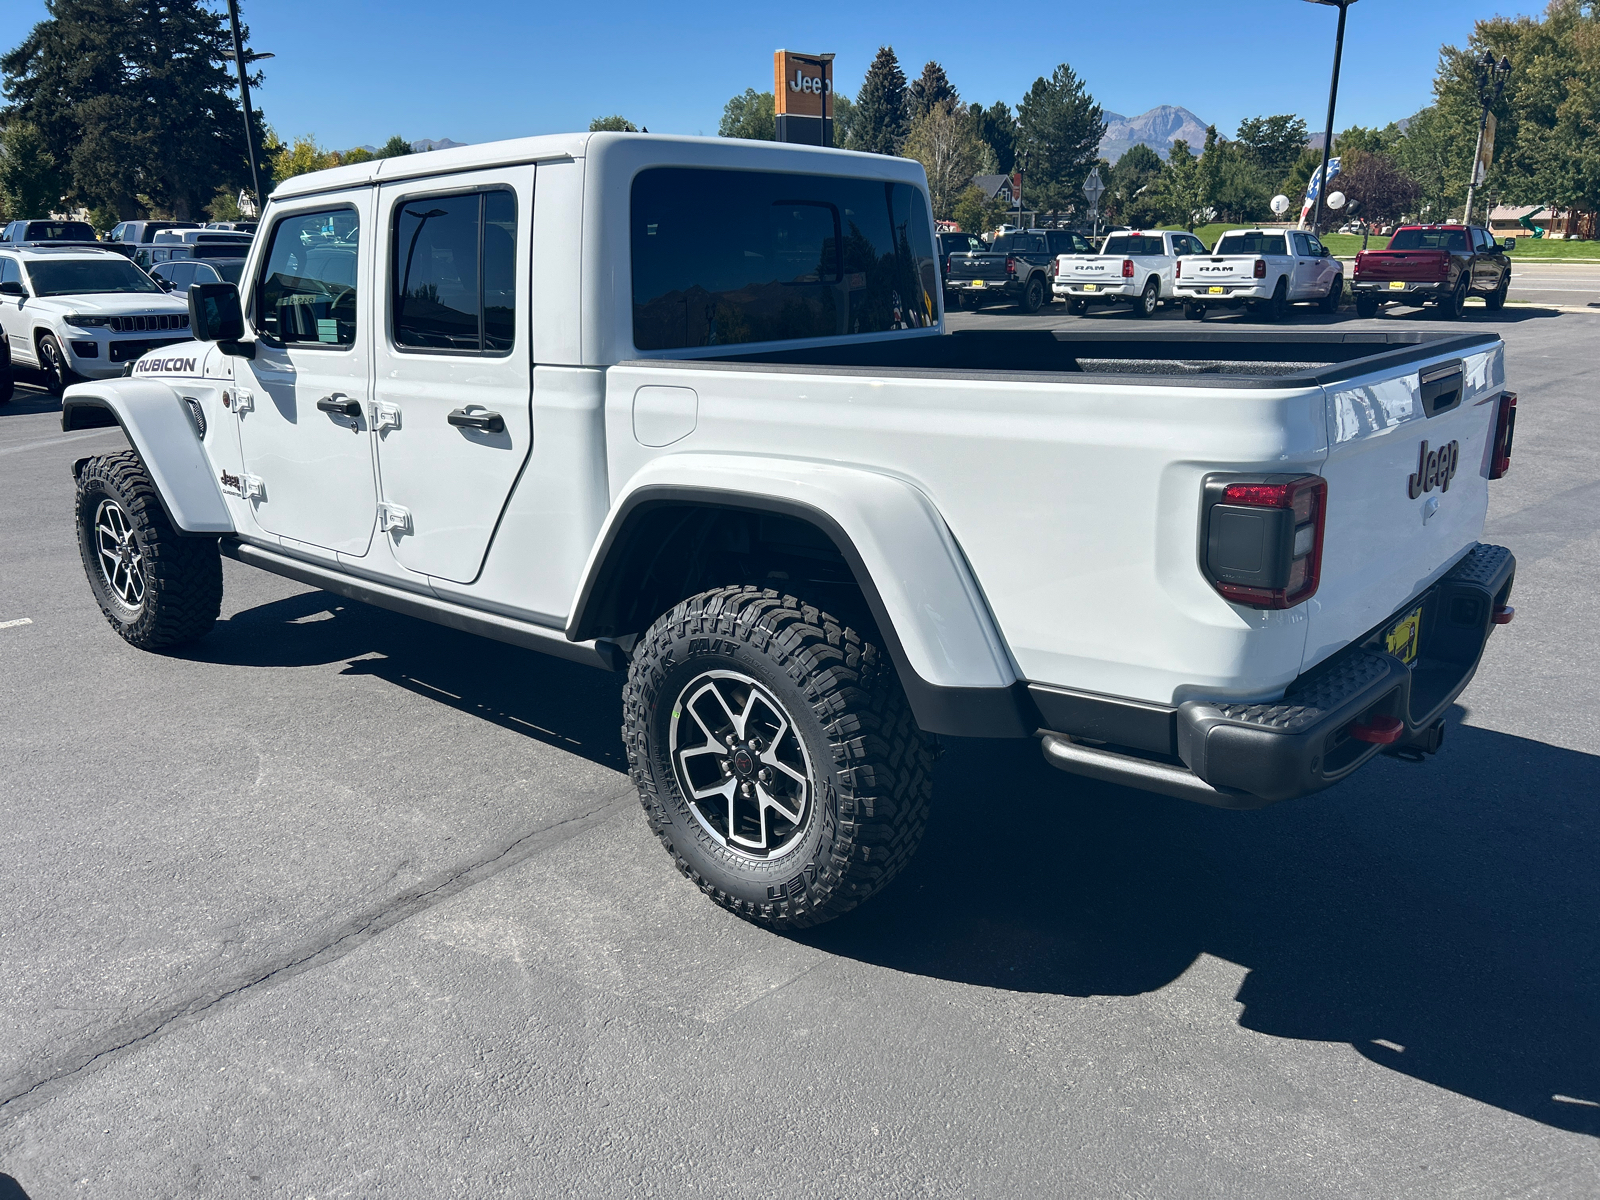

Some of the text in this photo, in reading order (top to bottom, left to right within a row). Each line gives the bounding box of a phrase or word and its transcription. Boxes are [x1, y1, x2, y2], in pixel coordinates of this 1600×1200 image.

[135, 357, 198, 373] RUBICON
[220, 468, 241, 492] Jeep
[1406, 439, 1459, 500] Jeep
[687, 636, 741, 657] M/T
